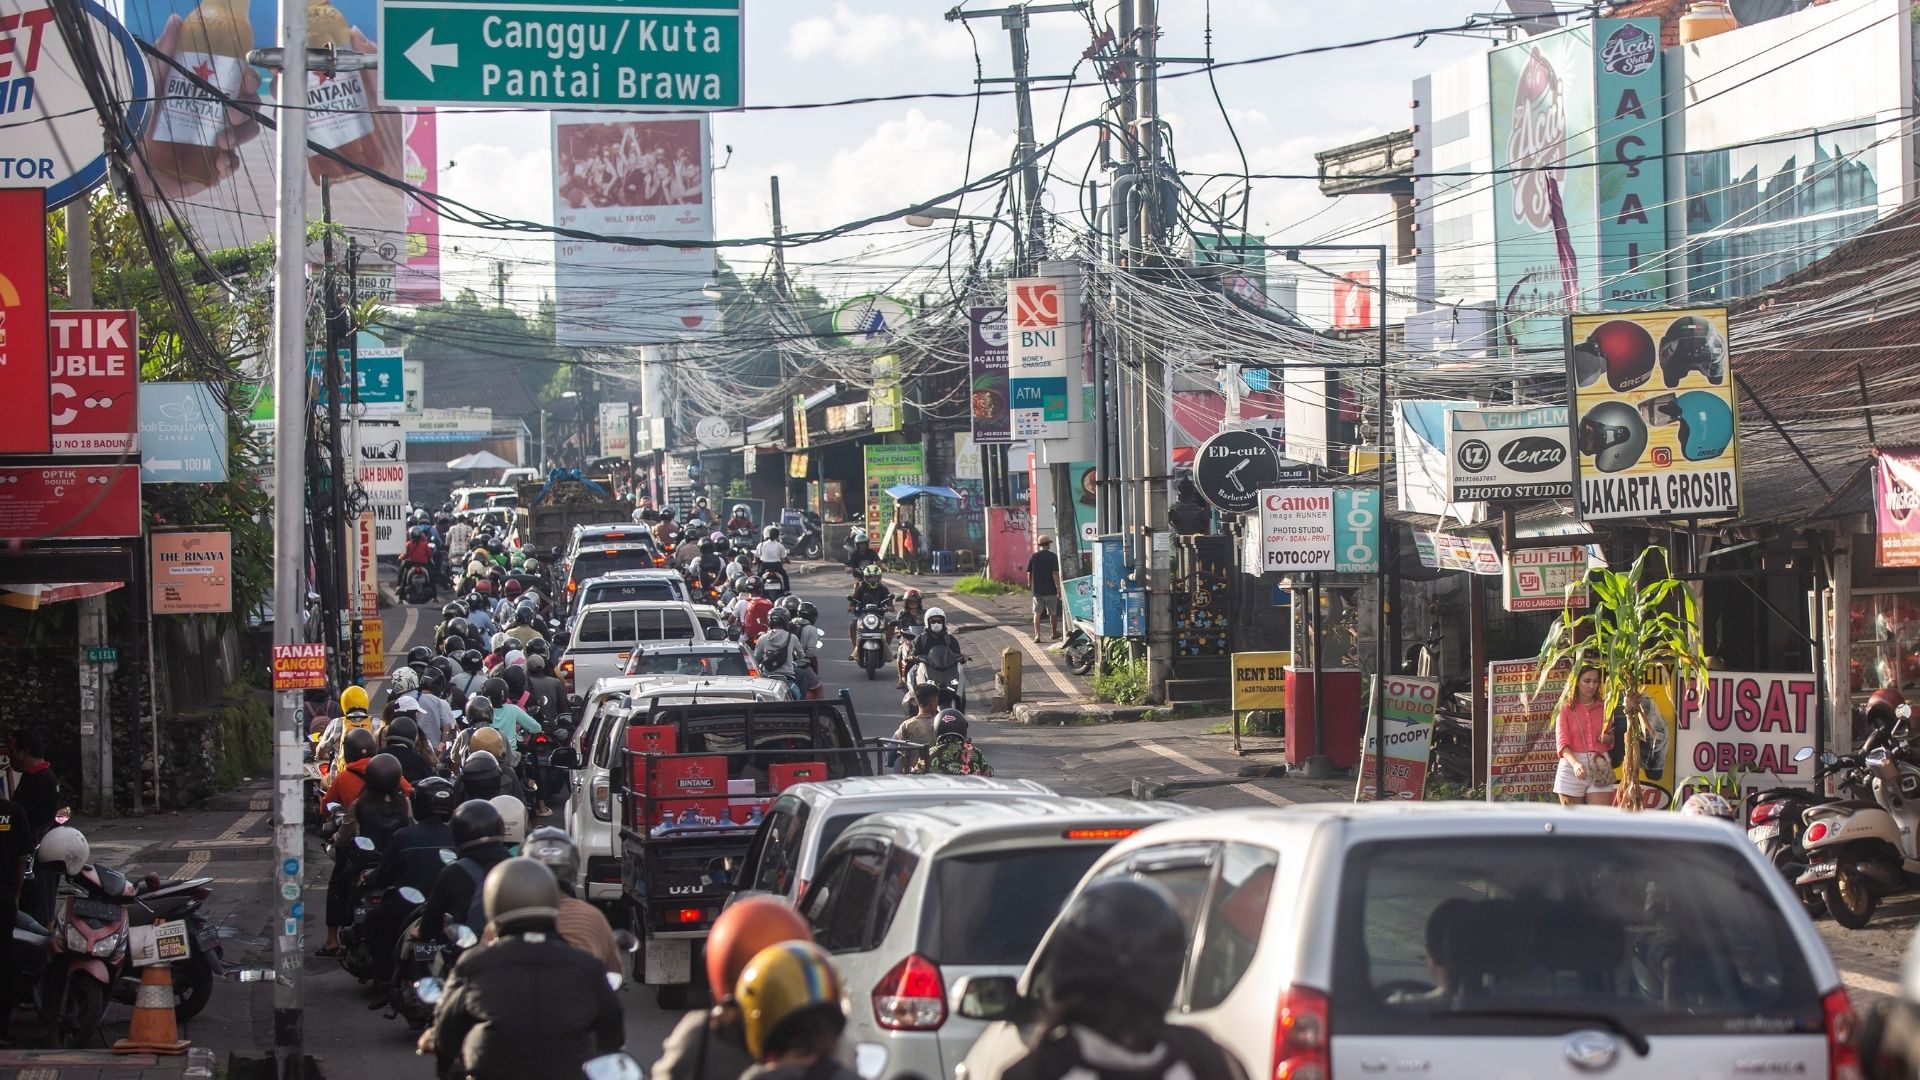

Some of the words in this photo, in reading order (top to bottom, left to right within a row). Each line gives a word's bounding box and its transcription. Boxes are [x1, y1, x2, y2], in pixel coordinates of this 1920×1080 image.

[482, 62, 600, 98] Pantai
[617, 66, 721, 100] Brawa
[0, 157, 56, 180] TOR
[1614, 88, 1649, 274] AÇAI
[604, 215, 624, 224] WILL
[625, 214, 656, 223] TAYLOR
[1611, 288, 1657, 301] BOWL
[51, 318, 129, 349] TIK
[1021, 331, 1056, 347] BNI
[974, 356, 994, 364] AÇAI
[1016, 387, 1041, 399] ATM
[1487, 411, 1522, 428] FUJI
[1527, 408, 1568, 425] FILM
[65, 440, 78, 449] NO
[81, 440, 91, 449] 18
[93, 439, 133, 449] BADUNG
[1209, 445, 1267, 458] ED-cutz
[1503, 441, 1562, 465] Lenza
[184, 458, 203, 472] 100
[204, 458, 212, 471] M
[891, 455, 921, 463] CHANGER
[42, 470, 77, 479] OPTIK
[377, 466, 403, 481] BUNDO
[54, 486, 65, 497] C
[1459, 487, 1512, 499] PHOTO
[1514, 484, 1572, 498] STUDIO
[1582, 475, 1662, 515] JAKARTA
[1666, 471, 1732, 509] GROSIR
[1265, 494, 1330, 511] Canon
[376, 525, 392, 541] HOP
[1298, 526, 1324, 534] STUDIO
[1346, 491, 1374, 564] FOTO
[160, 551, 181, 562] THE
[184, 551, 225, 561] RINAYA
[1268, 550, 1331, 565] FOTOCOPY
[1513, 552, 1543, 565] FUJI
[1548, 550, 1583, 563] FILM
[1336, 563, 1372, 573] STUDIO
[1513, 600, 1531, 608] FOTO
[1569, 597, 1585, 606] JADI
[273, 644, 325, 658] TANAH
[362, 638, 381, 655] EY
[274, 657, 325, 671] CANGGU
[1496, 663, 1529, 673] PHOTO
[1236, 667, 1265, 682] RENT
[1496, 673, 1532, 683] PHOTO
[1537, 692, 1561, 701] PRIN
[1375, 697, 1434, 714] TUDIO
[1496, 702, 1556, 713] PREWEDDIN
[1678, 676, 1816, 734] PUSAT
[1502, 712, 1552, 723] WEDDIN
[1495, 725, 1521, 734] VIDEO
[1368, 727, 1430, 749] FTOCOPY
[1493, 735, 1521, 744] KARTU
[1496, 756, 1526, 764] CETAK
[1527, 751, 1559, 761] KANVA
[1692, 741, 1799, 775] OBRAL
[1500, 765, 1525, 774] EDIT
[679, 779, 711, 787] BINTANG
[1529, 773, 1556, 782] BALIH
[1501, 783, 1553, 794] FOTOCOP
